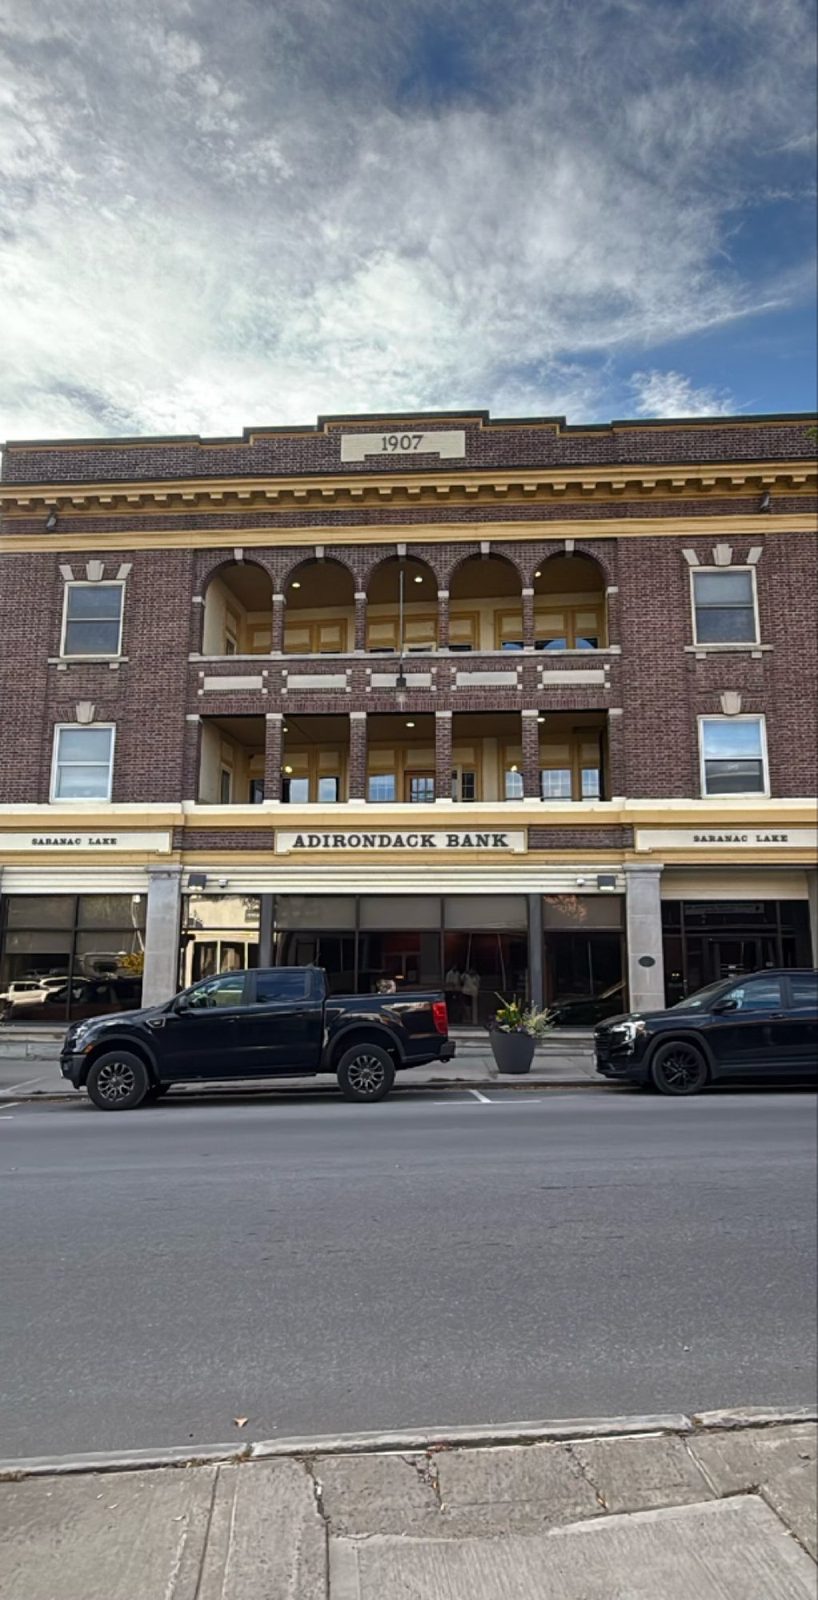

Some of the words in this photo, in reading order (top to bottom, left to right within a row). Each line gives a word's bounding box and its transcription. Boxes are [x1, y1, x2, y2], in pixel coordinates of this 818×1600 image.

[381, 434, 424, 452] 1907
[31, 838, 82, 846] SARANAC
[88, 838, 118, 846] LAKE
[292, 834, 437, 848] ADIRONDACK
[446, 834, 509, 848] BANK
[693, 835, 749, 843] SARANAC
[756, 834, 789, 843] LAKE
